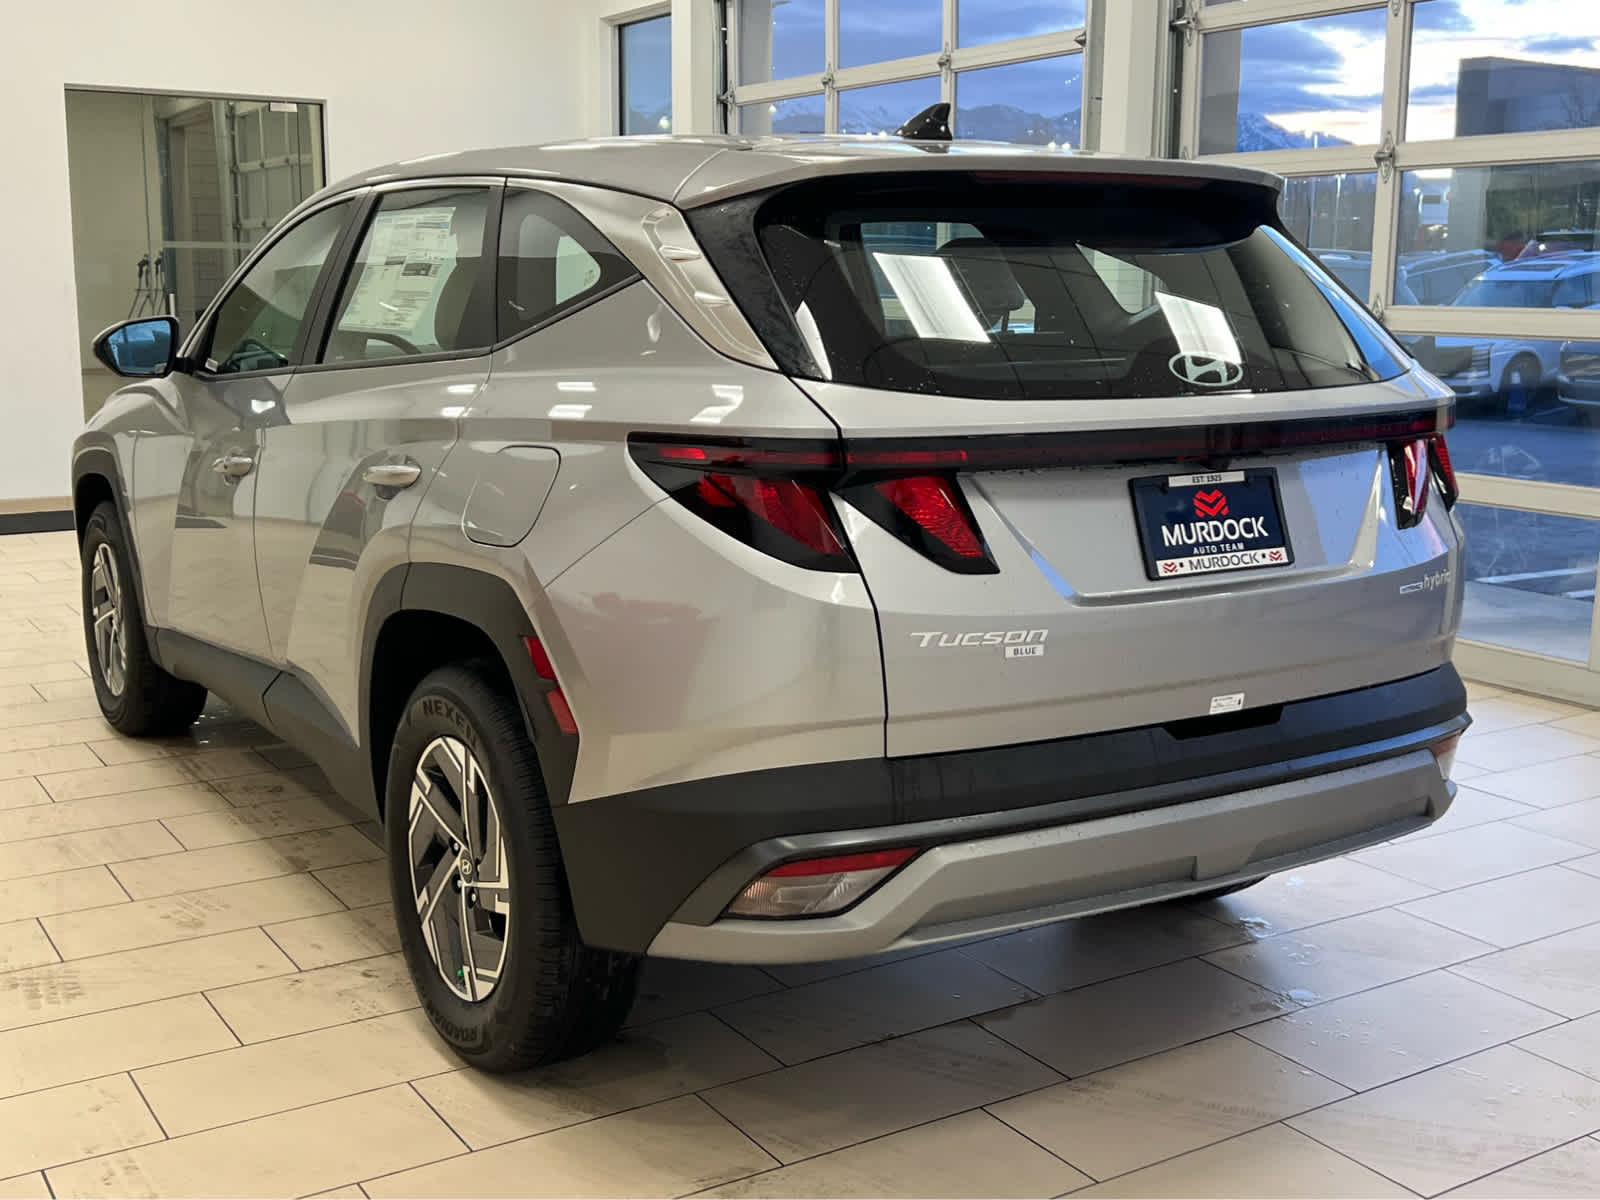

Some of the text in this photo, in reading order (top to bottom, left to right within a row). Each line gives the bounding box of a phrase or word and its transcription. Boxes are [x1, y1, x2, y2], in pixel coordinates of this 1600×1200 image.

[1160, 516, 1269, 547] MURDOCK
[1193, 542, 1245, 555] AUTO TEAM
[1188, 552, 1260, 571] MURDOCK
[1013, 646, 1037, 656] BLUE
